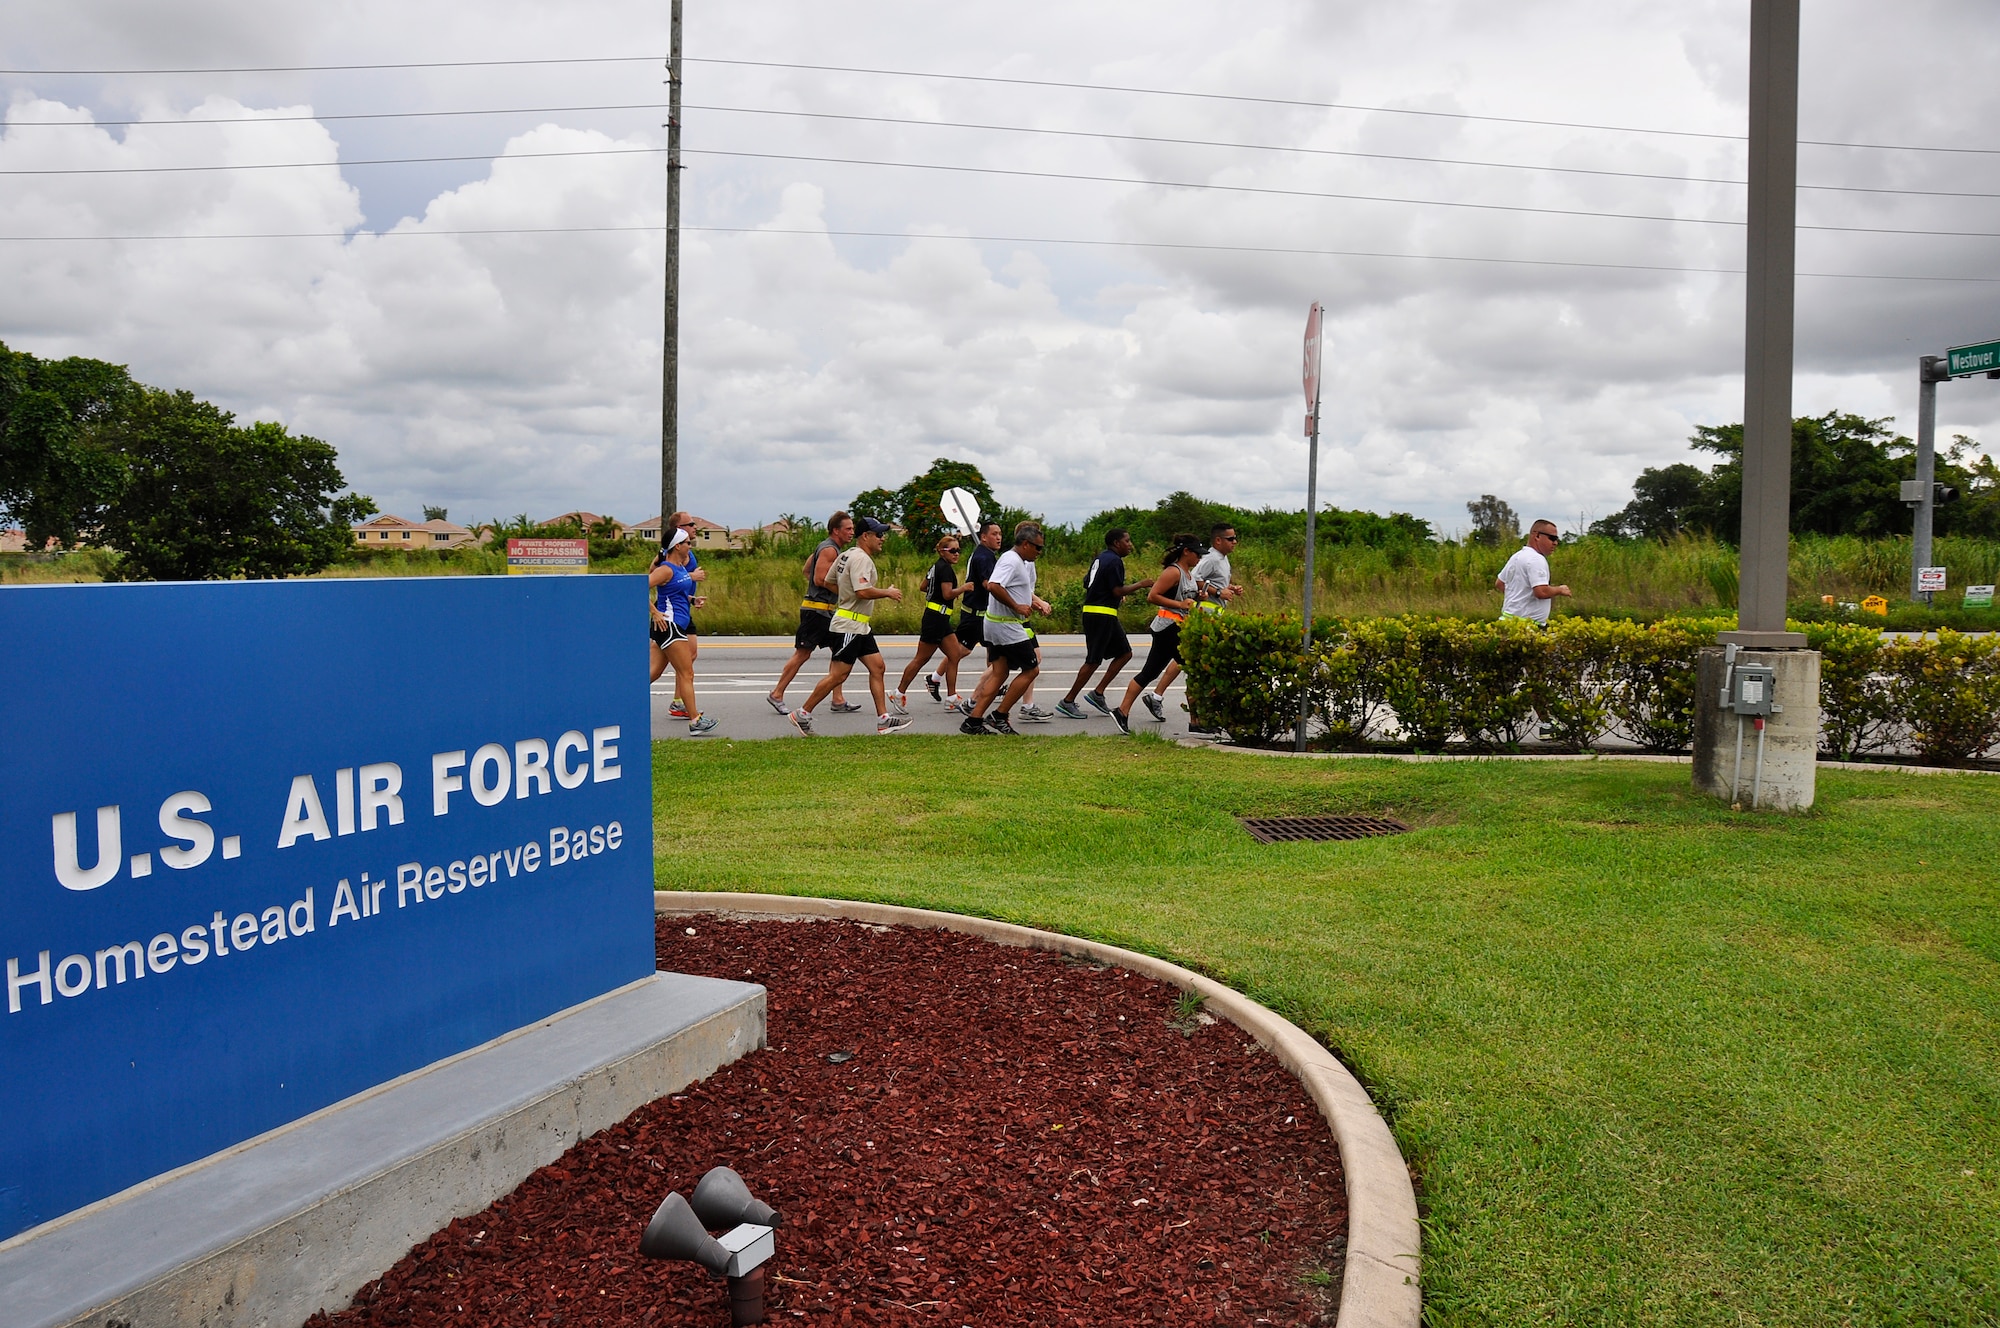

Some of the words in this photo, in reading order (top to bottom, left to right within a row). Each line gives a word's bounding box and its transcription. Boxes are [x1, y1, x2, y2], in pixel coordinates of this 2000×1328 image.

[1304, 334, 1320, 379] ST
[1951, 351, 1993, 370] Westover
[511, 547, 523, 556] NO
[526, 547, 584, 556] TRESPASSING
[53, 791, 241, 890] U.S.
[277, 763, 404, 848] AIR
[433, 726, 621, 816] FORCE
[7, 887, 314, 1013] Homestead
[329, 873, 385, 926] Air
[397, 842, 541, 908] Reserve
[550, 822, 623, 866] Base
